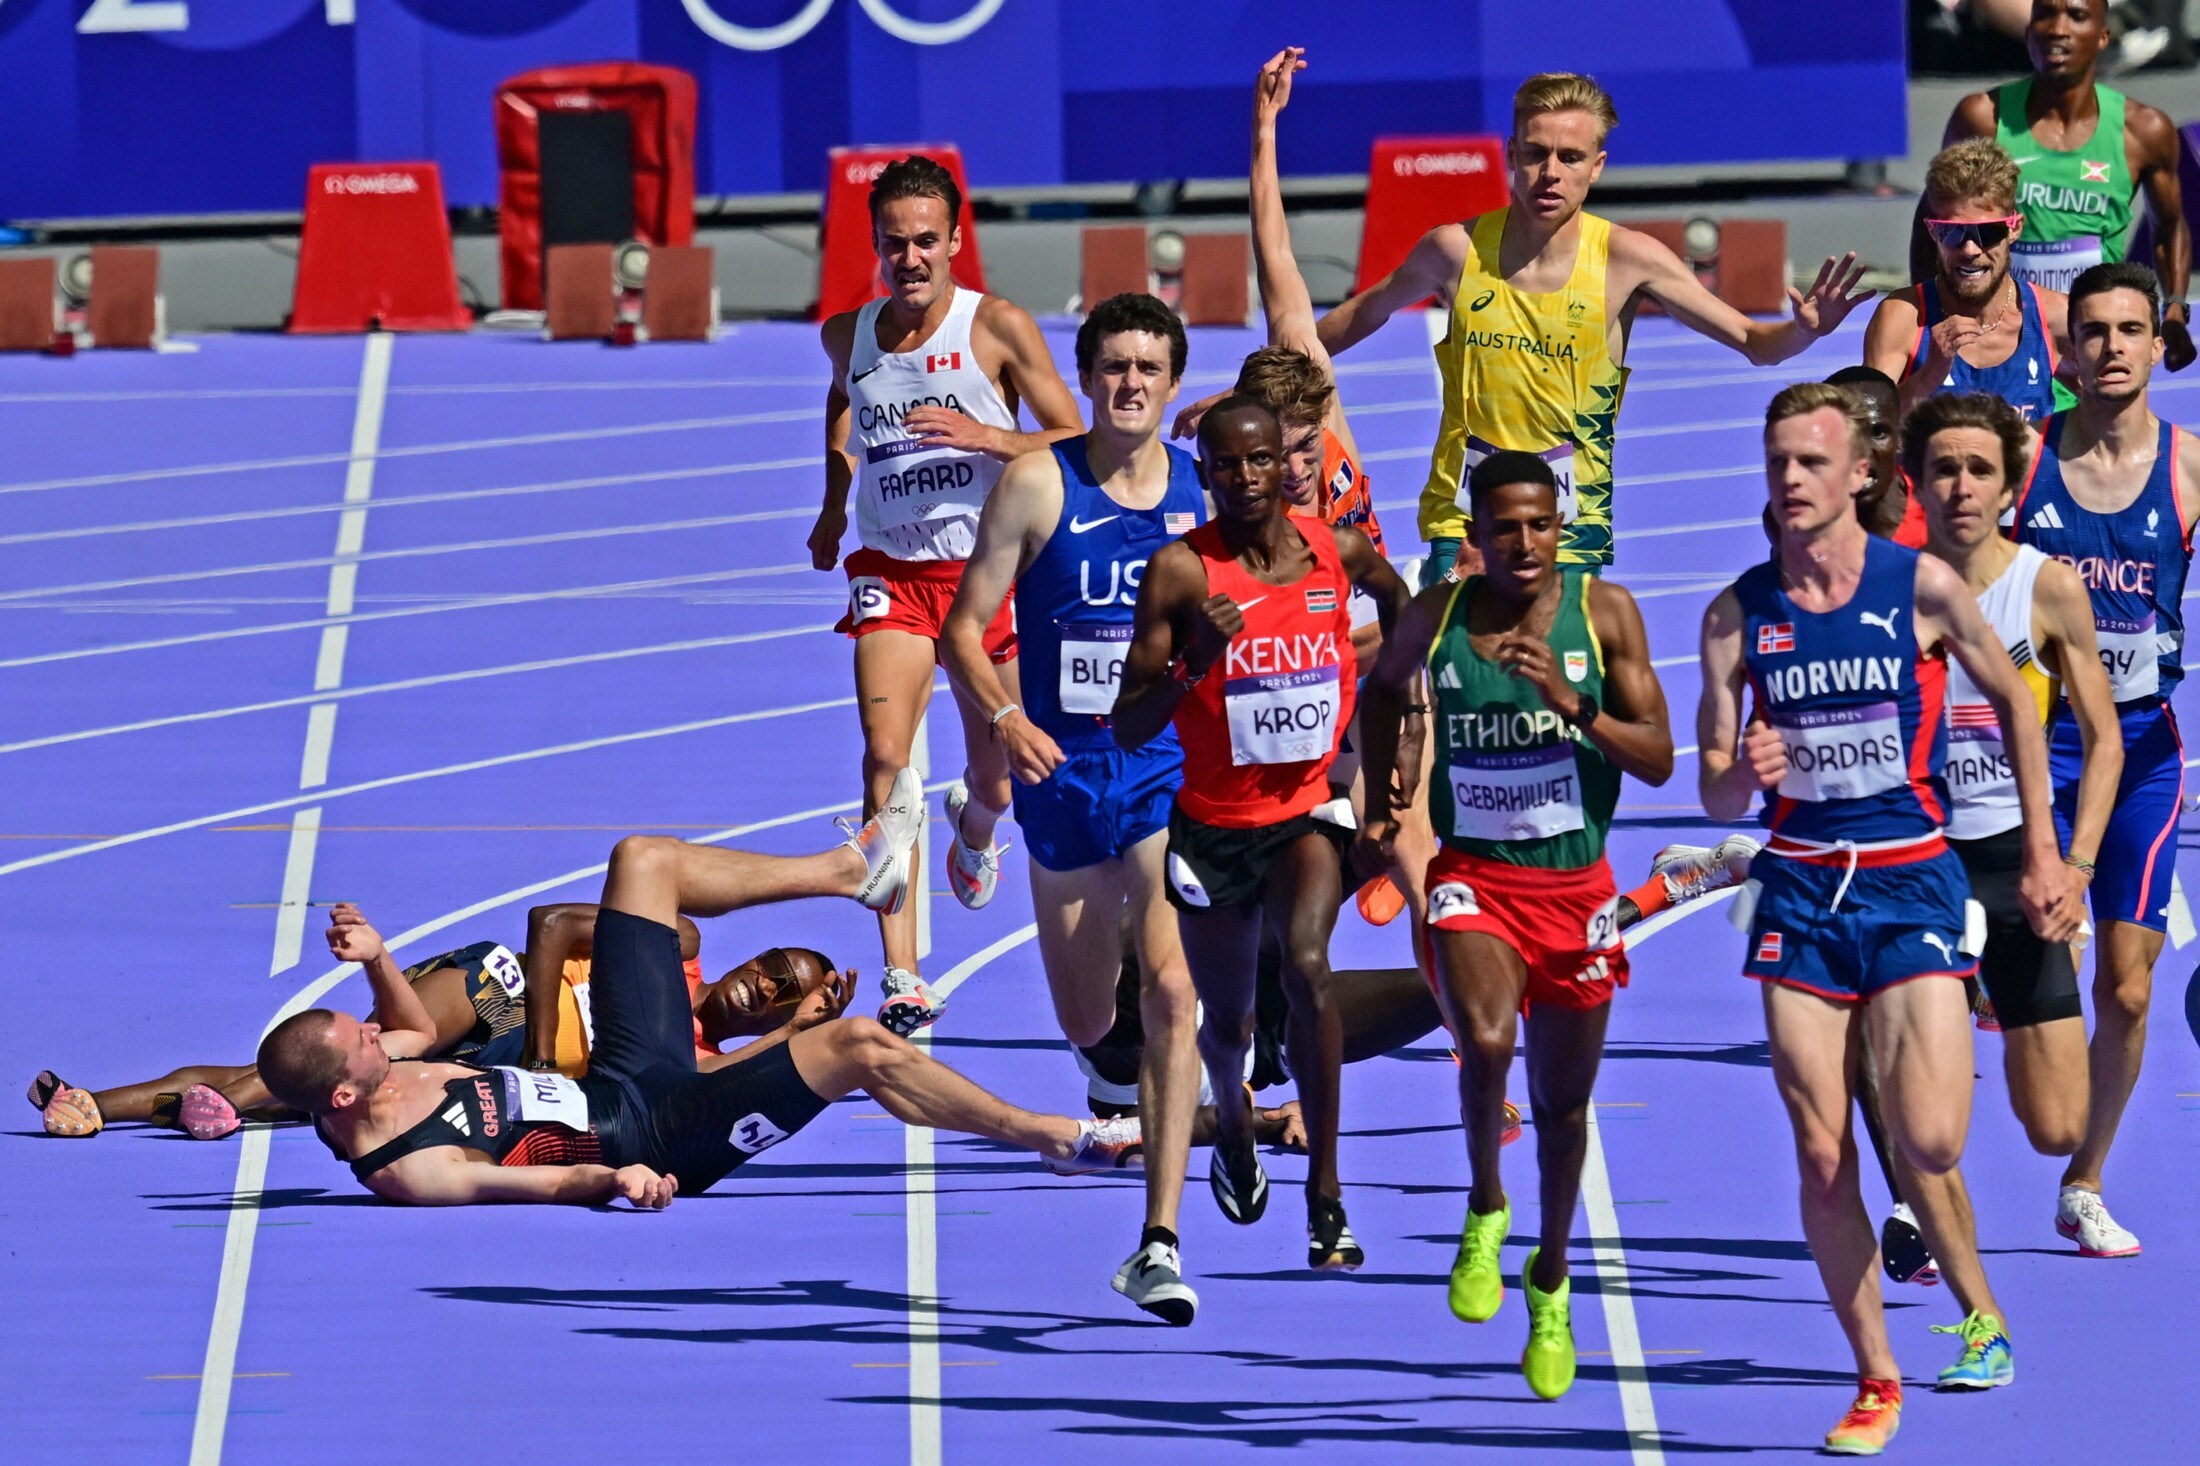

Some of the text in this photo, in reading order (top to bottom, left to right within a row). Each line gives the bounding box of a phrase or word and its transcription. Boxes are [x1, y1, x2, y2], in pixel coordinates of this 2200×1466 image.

[345, 173, 418, 195] OMEGA
[2015, 182, 2110, 215] URUNDI
[2015, 243, 2042, 252] PARIS
[1466, 331, 1574, 359] AUSTRALIA
[885, 442, 915, 454] PARIS
[879, 462, 974, 502] FAFARD
[1080, 560, 1149, 606] US
[2052, 555, 2156, 596] ANCE
[853, 584, 882, 614] 15
[1095, 629, 1127, 638] PARIS
[2110, 620, 2140, 631] 2024
[1226, 632, 1340, 675] KENYA
[2098, 649, 2136, 675] AY
[1072, 658, 1125, 685] BLA
[1259, 676, 1292, 688] PARIS
[1766, 656, 1902, 704] NORWAY
[1254, 700, 1330, 735] KROP
[1794, 711, 1862, 725] PARIS 2024
[1476, 757, 1508, 767] PARIS
[1785, 734, 1900, 772] NORDAS
[1946, 754, 2013, 786] MANS
[1456, 775, 1573, 813] GEBRHIWET
[867, 854, 894, 893] RUNNING
[1596, 910, 1615, 942] 21
[493, 955, 520, 990] 13
[530, 1075, 562, 1104] MIL
[474, 1079, 499, 1138] GREAT
[740, 1120, 776, 1148] 14
